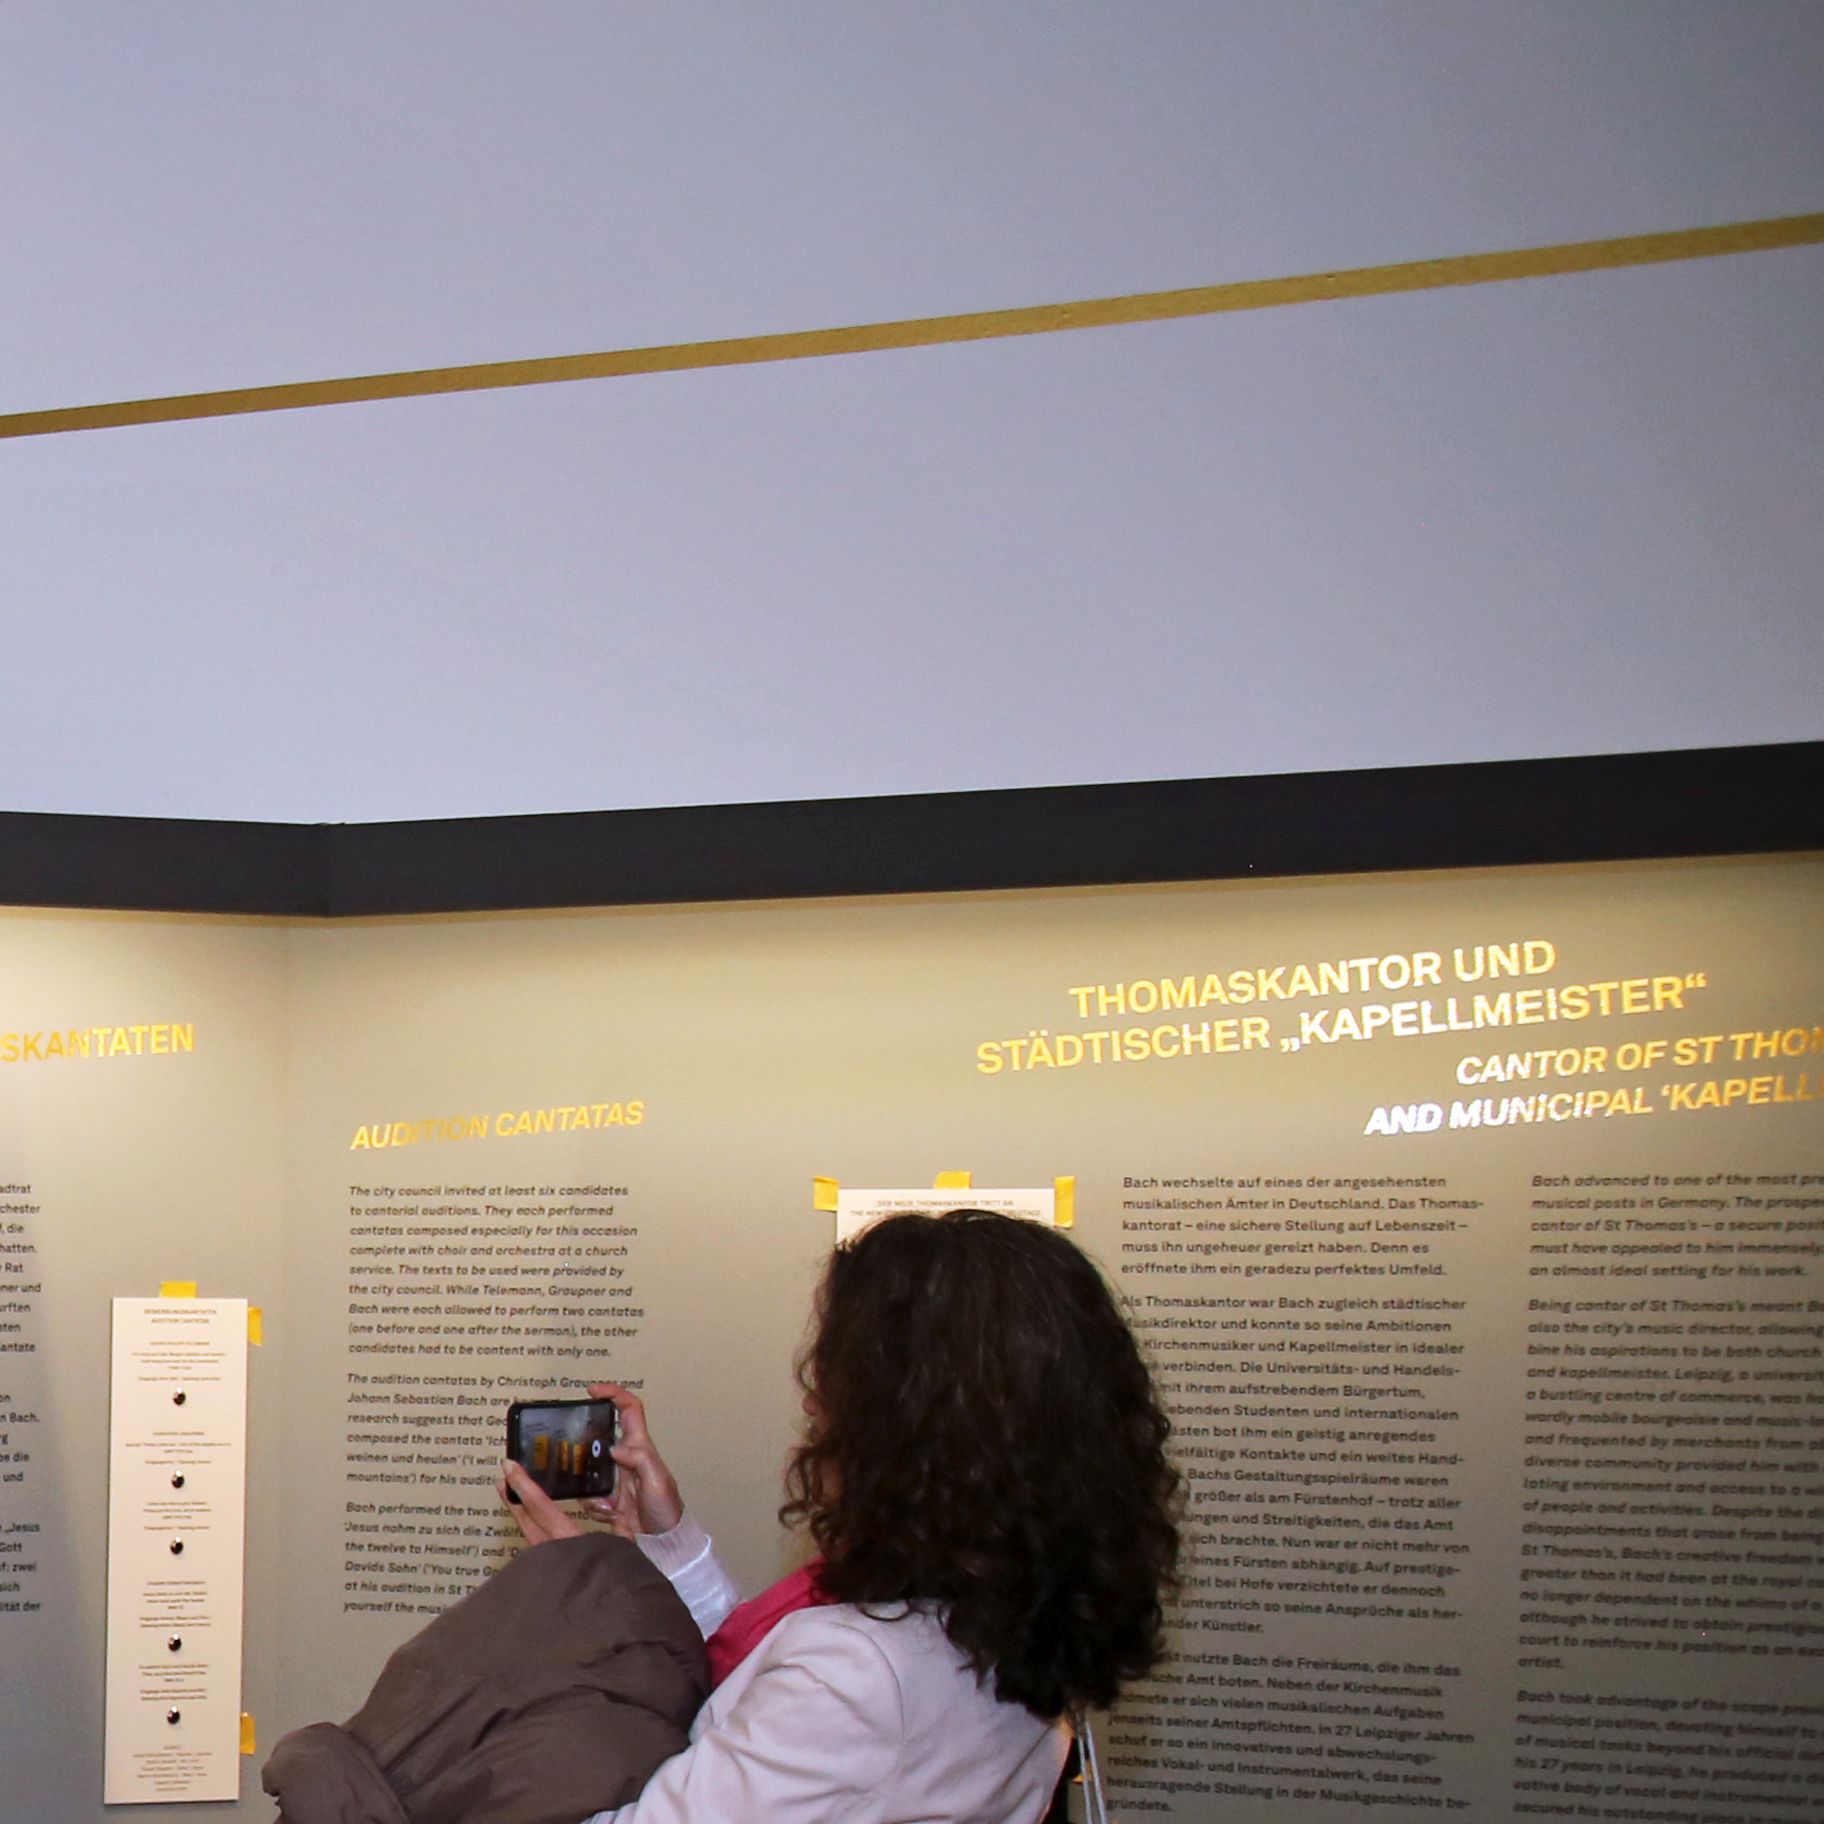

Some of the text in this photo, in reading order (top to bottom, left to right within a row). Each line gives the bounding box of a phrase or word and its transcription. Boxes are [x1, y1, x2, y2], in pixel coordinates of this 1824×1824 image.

[1069, 940, 1556, 1019] THOMASKANTOR UND
[977, 1017, 1272, 1076] STÄDTISCHER
[1456, 1046, 1607, 1087] CANTOR
[1616, 1041, 1665, 1071] OF
[1674, 1035, 1725, 1068] ST
[350, 1101, 645, 1149] AUDITION CANTATAS
[1364, 1102, 1444, 1137] AND
[1449, 1087, 1654, 1129] MUNICIPAL
[1124, 1177, 1446, 1190] Bach wechselte auf eines der angesehensten
[350, 1206, 613, 1217] to cantorial auditions. They each performed
